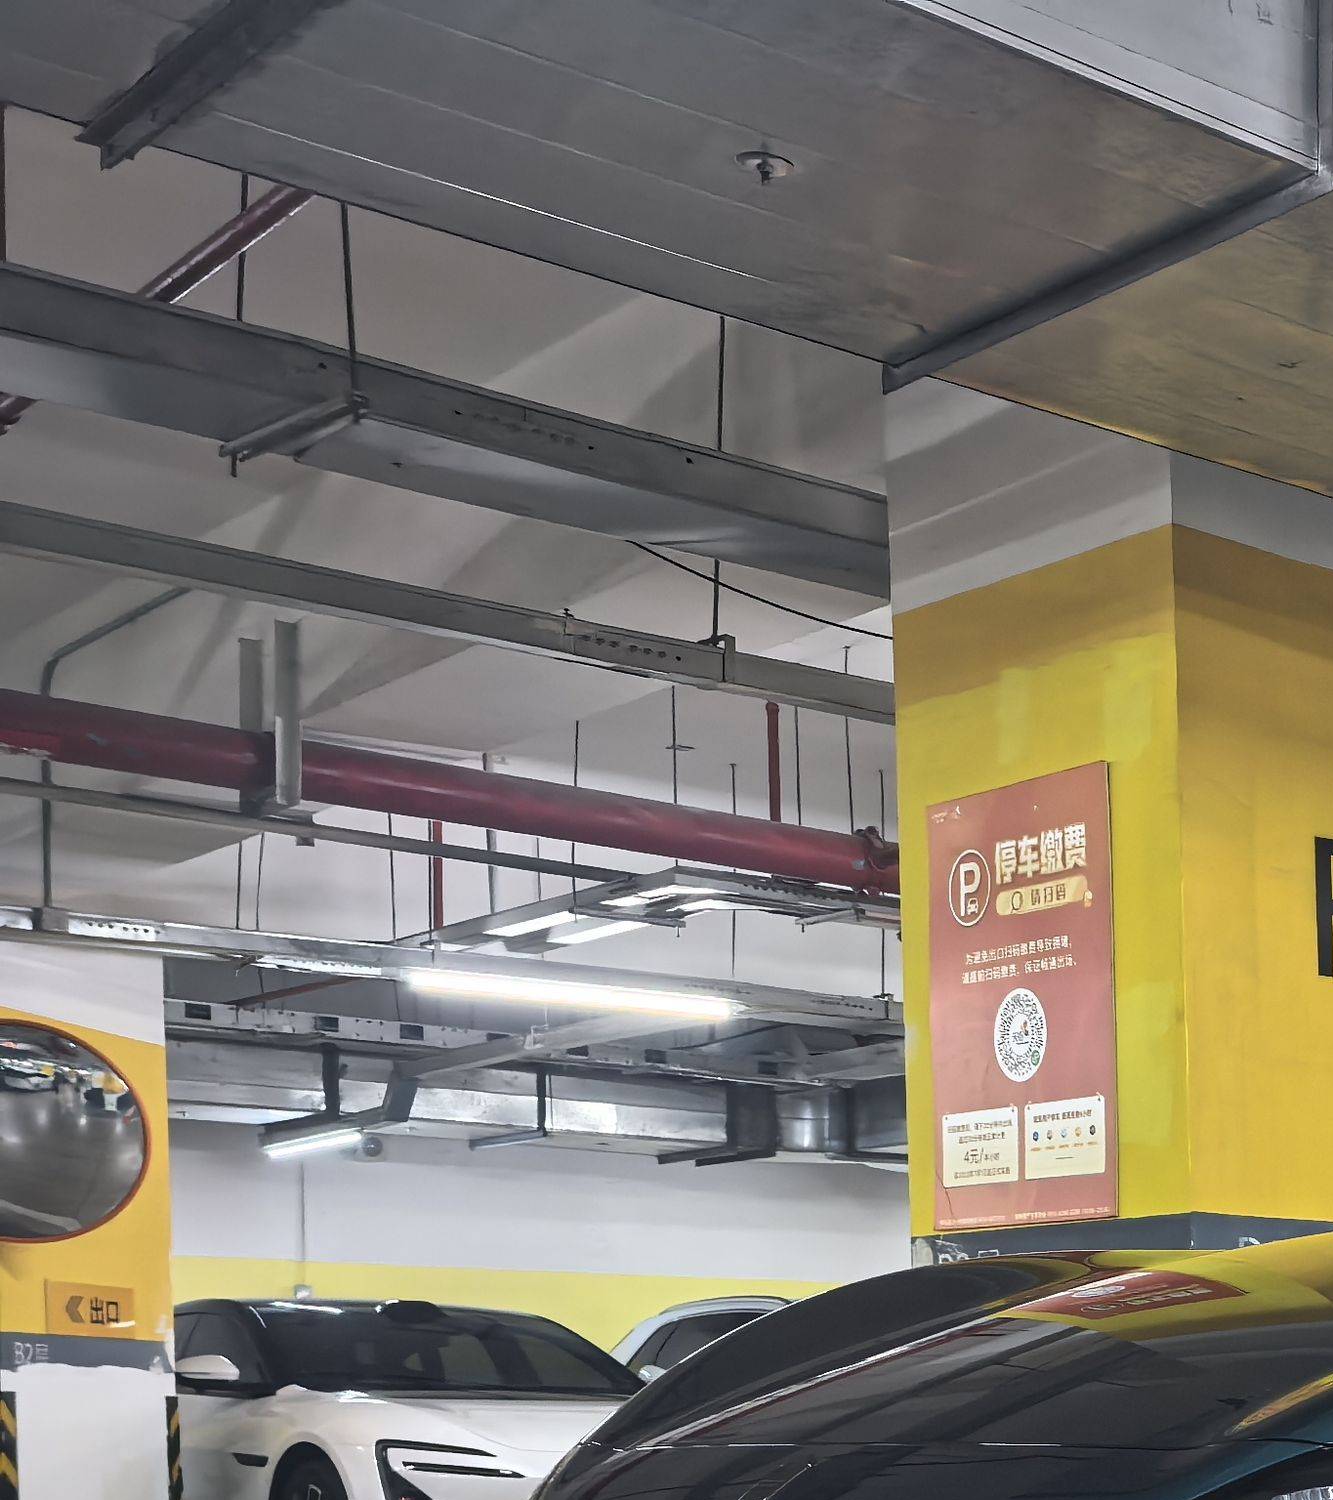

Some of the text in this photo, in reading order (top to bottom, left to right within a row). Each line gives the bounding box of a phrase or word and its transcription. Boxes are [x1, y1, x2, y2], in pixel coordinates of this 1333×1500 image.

[994, 821, 1087, 885] 停车缴费
[89, 1296, 121, 1325] 出口
